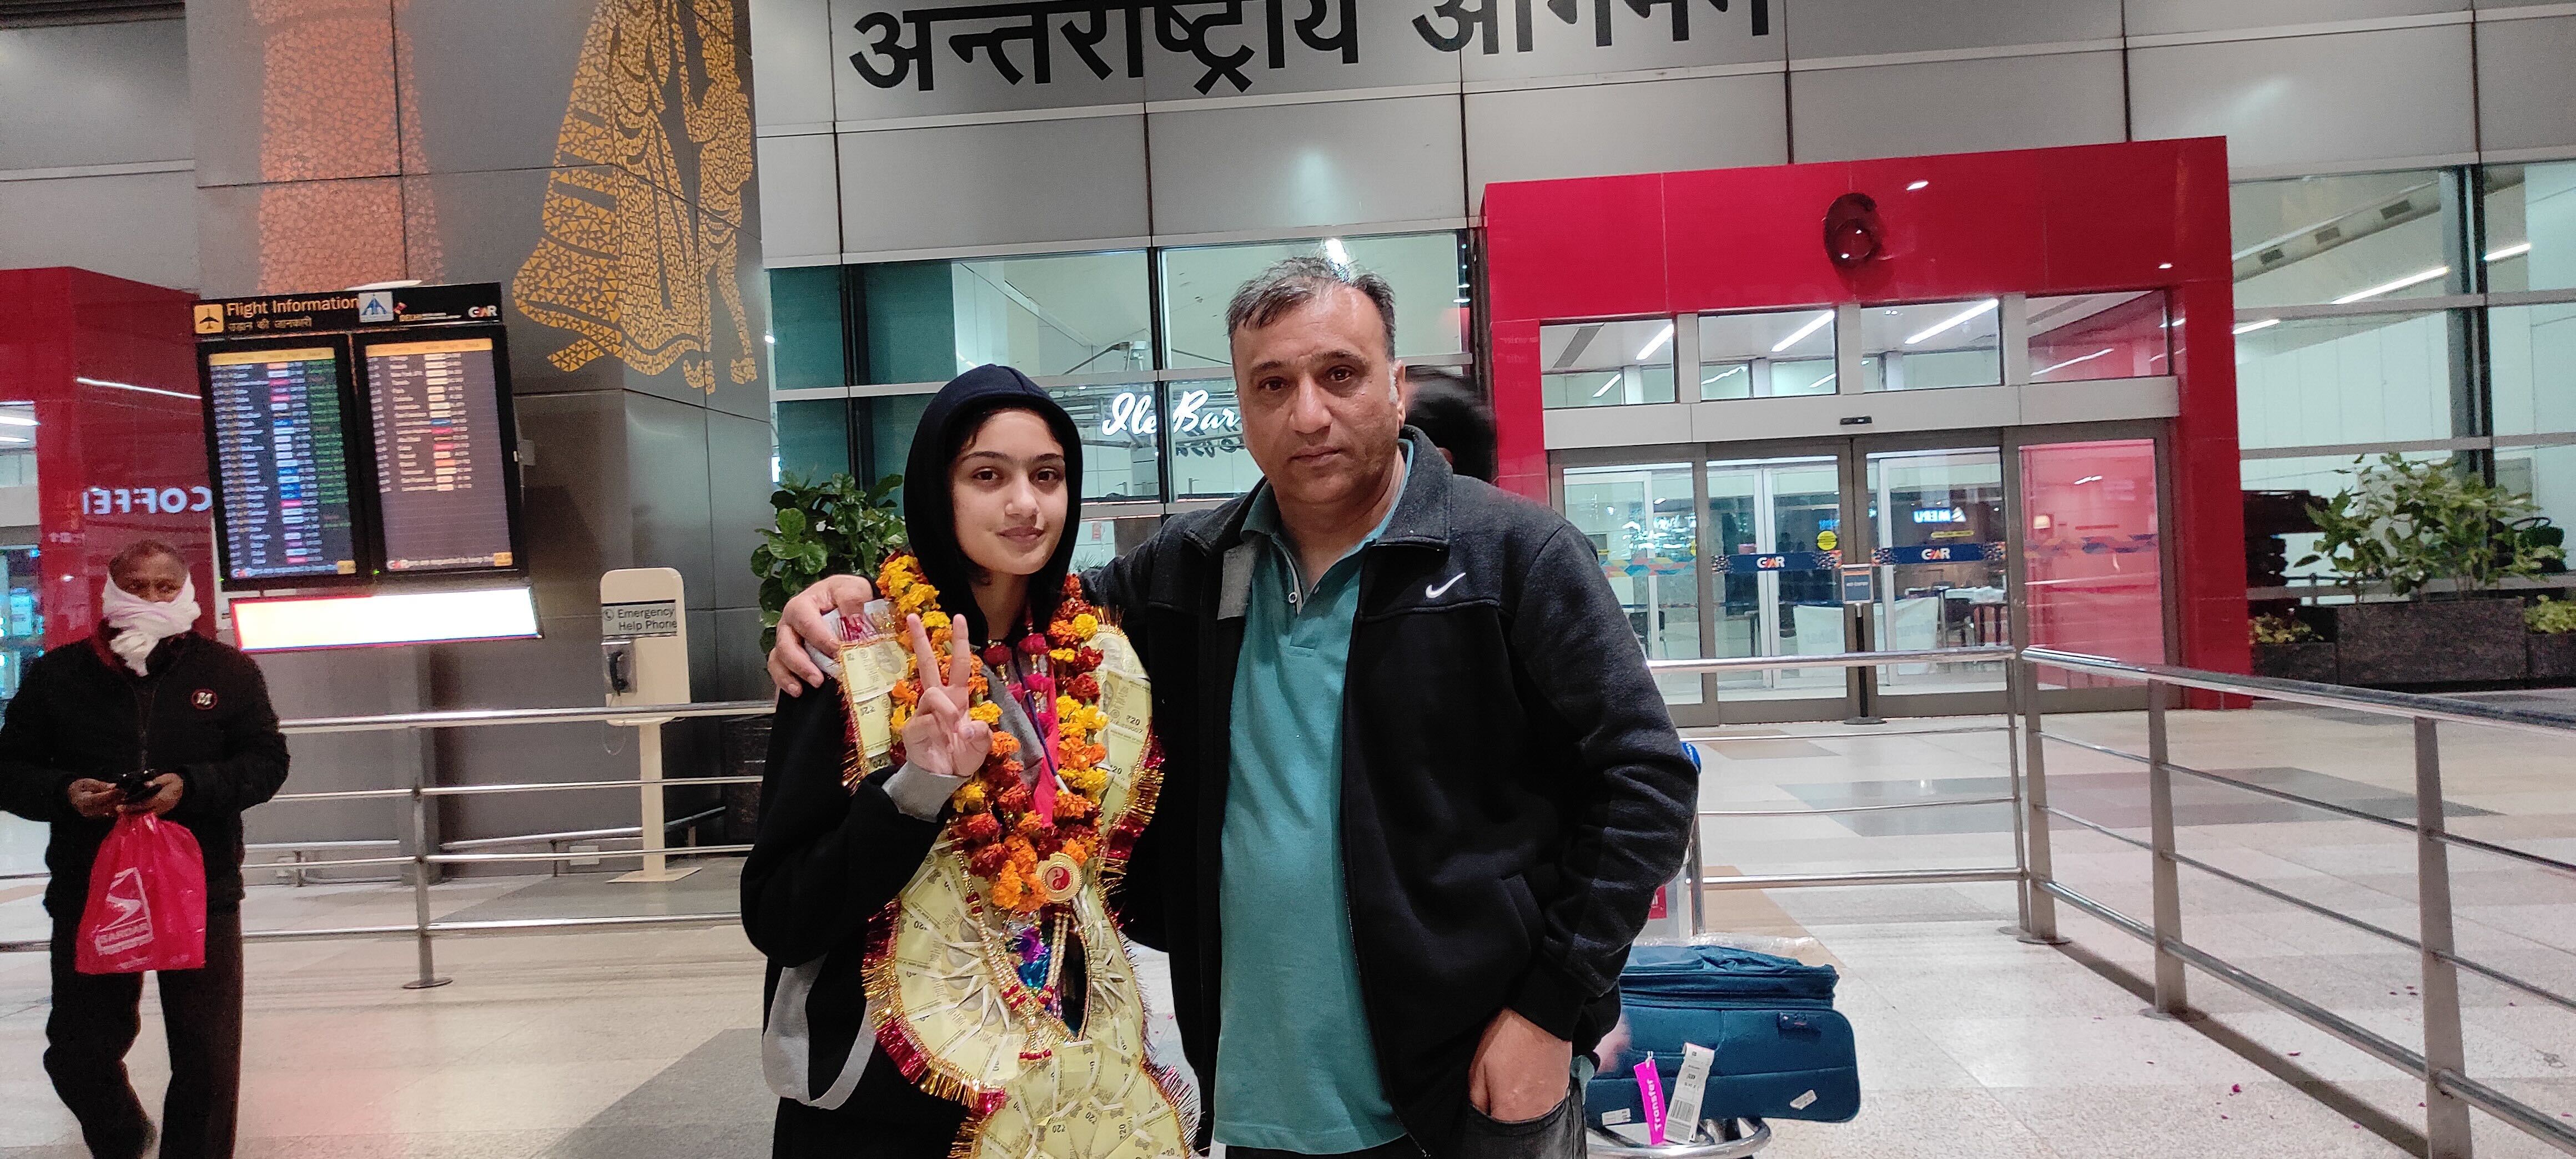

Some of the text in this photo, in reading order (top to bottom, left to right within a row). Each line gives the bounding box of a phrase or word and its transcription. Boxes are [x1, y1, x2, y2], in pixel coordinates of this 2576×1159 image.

[226, 296, 359, 319] Flight Information
[1173, 389, 1241, 433] Bar
[617, 608, 675, 619] Emergency
[618, 618, 677, 631] Help Phone
[1126, 714, 1141, 726] ₹20
[1647, 1078, 1662, 1132] Transfer
[1052, 1124, 1066, 1133] ₹20
